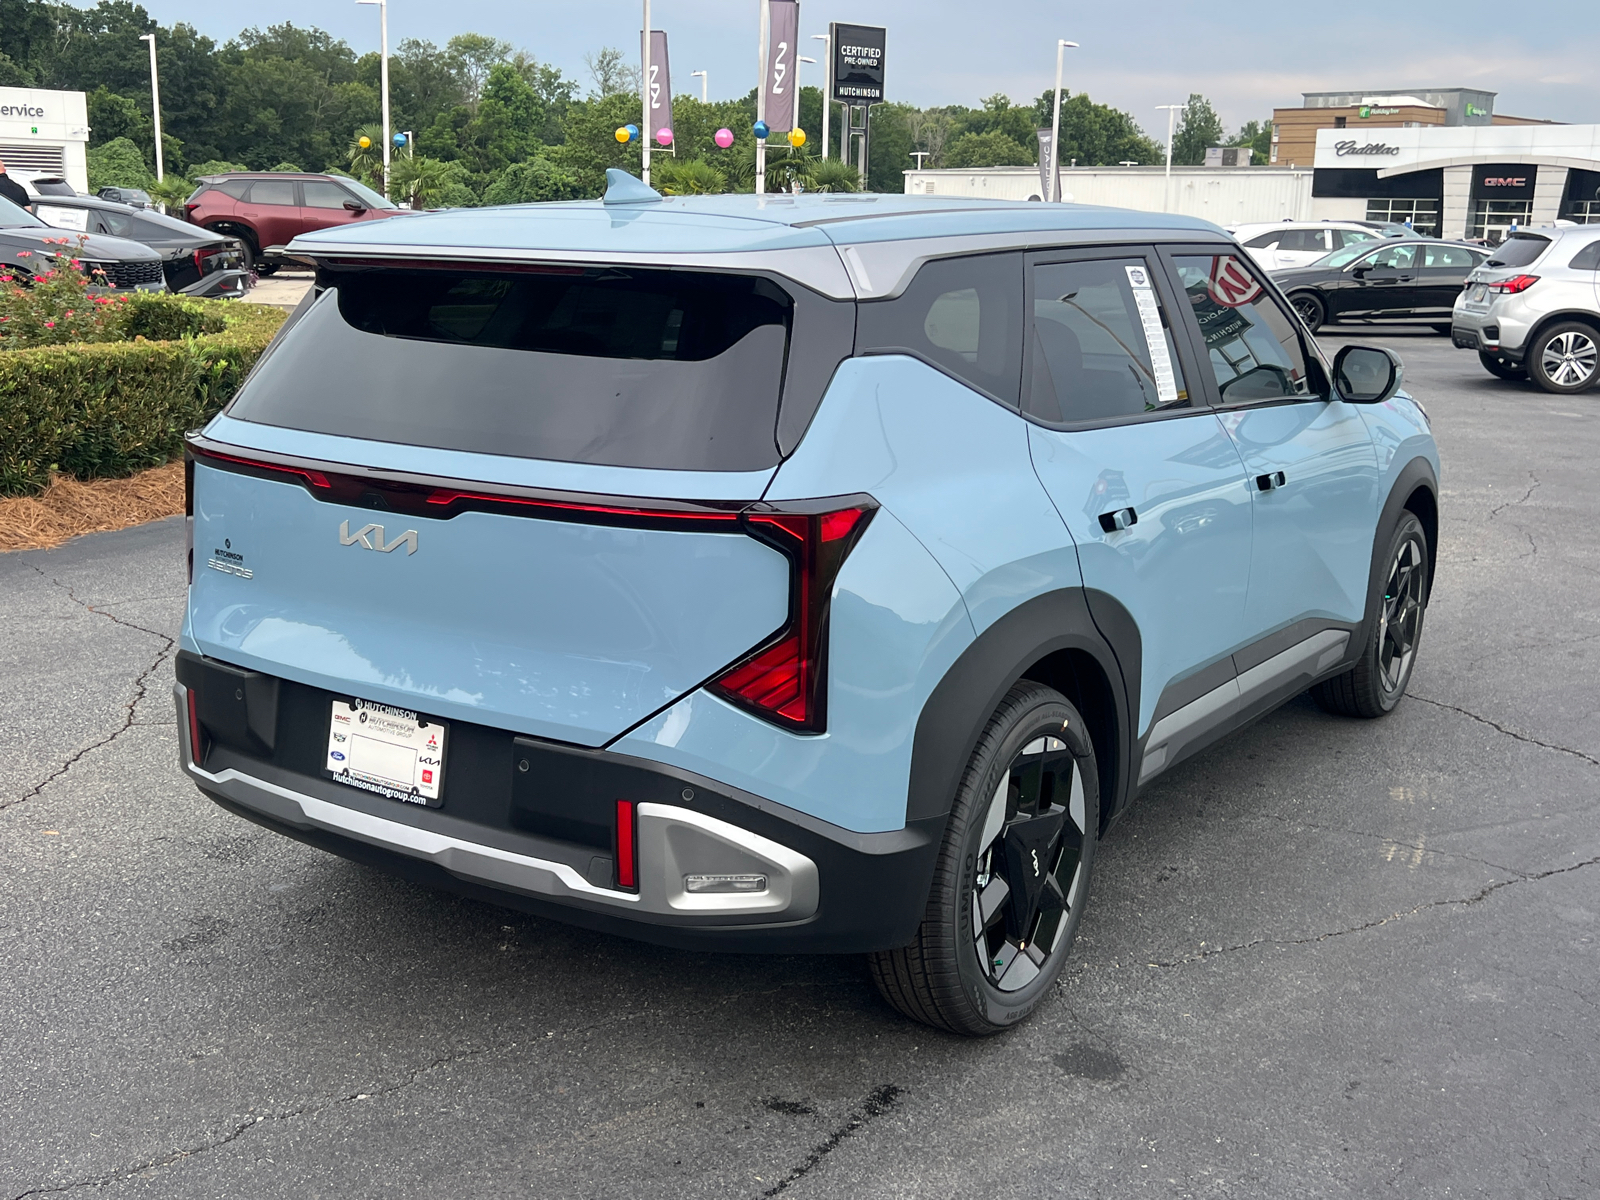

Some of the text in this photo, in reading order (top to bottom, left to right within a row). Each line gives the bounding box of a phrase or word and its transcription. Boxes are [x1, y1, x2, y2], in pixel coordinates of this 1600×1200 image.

[841, 45, 881, 58] CERTIFIED
[844, 57, 878, 66] PRE-OWNED
[839, 86, 880, 98] HUTCHINSON
[0, 103, 44, 117] ervice
[1334, 140, 1400, 157] Cadillac
[1484, 177, 1527, 187] GMC
[339, 519, 419, 557] KIA
[214, 548, 244, 562] HUTCHINSON
[364, 700, 418, 721] HUTCHINSON
[334, 714, 351, 723] GMC
[369, 716, 416, 734] HUTCHINSON
[368, 724, 412, 739] AUTOMOTIVE GROUP
[419, 755, 441, 767] KIA
[332, 771, 427, 806] Hutchinsonautogroup.com
[961, 853, 974, 946] KUMHO
